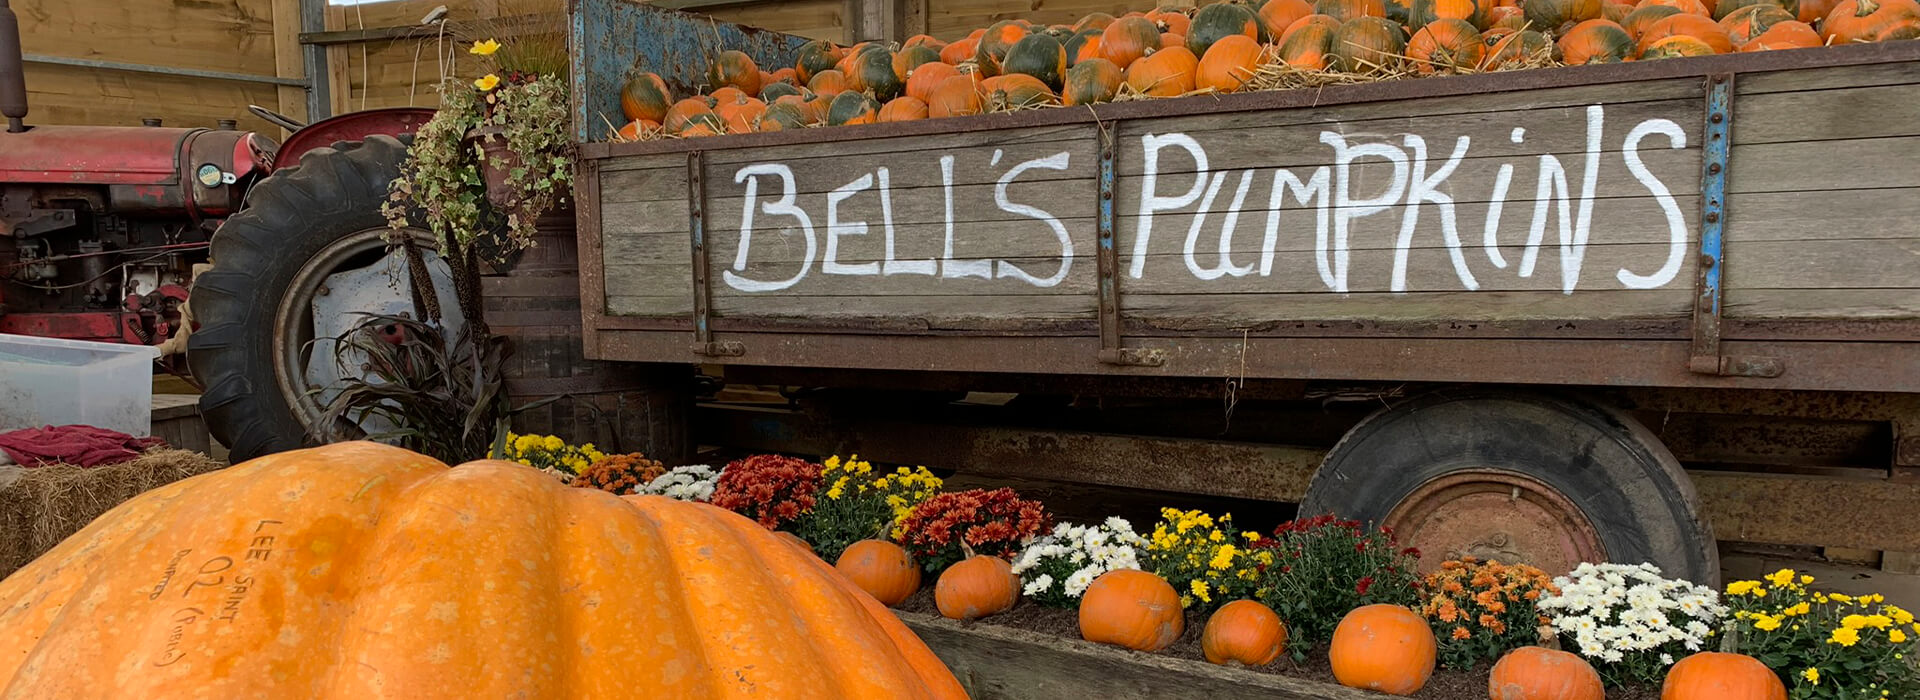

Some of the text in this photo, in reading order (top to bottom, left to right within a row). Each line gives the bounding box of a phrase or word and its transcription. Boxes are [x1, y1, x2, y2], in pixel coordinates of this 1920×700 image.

[149, 548, 193, 601] DONATED
[219, 520, 283, 624] LEE SAINT
